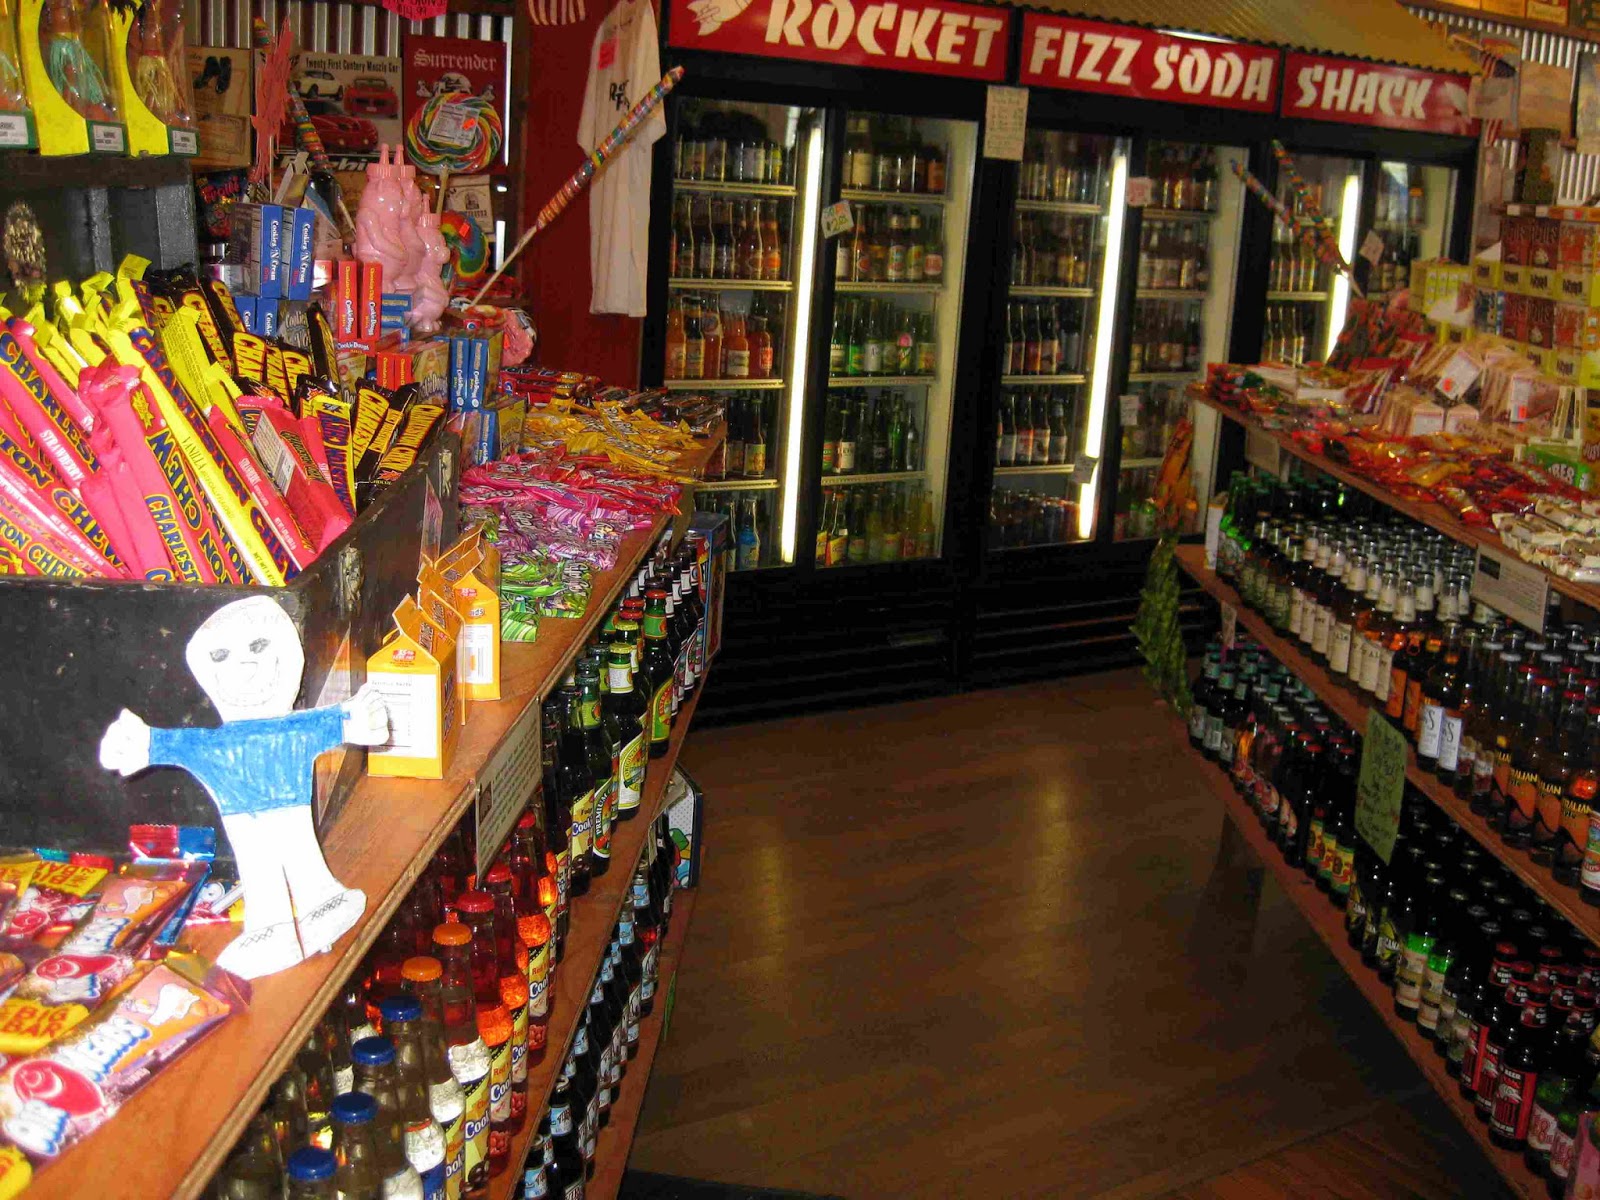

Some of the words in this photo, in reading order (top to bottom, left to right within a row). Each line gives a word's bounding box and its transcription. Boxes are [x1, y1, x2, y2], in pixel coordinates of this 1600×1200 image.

[764, 0, 1003, 67] ROCKET
[306, 58, 326, 70] Twenty
[328, 59, 341, 69] First
[414, 49, 497, 72] Surrender
[1029, 26, 1143, 86] FIZZ
[1152, 42, 1275, 103] SODA
[1295, 66, 1433, 120] SHACK
[182, 436, 207, 471] VANILLA
[596, 792, 608, 835] PREMIUM
